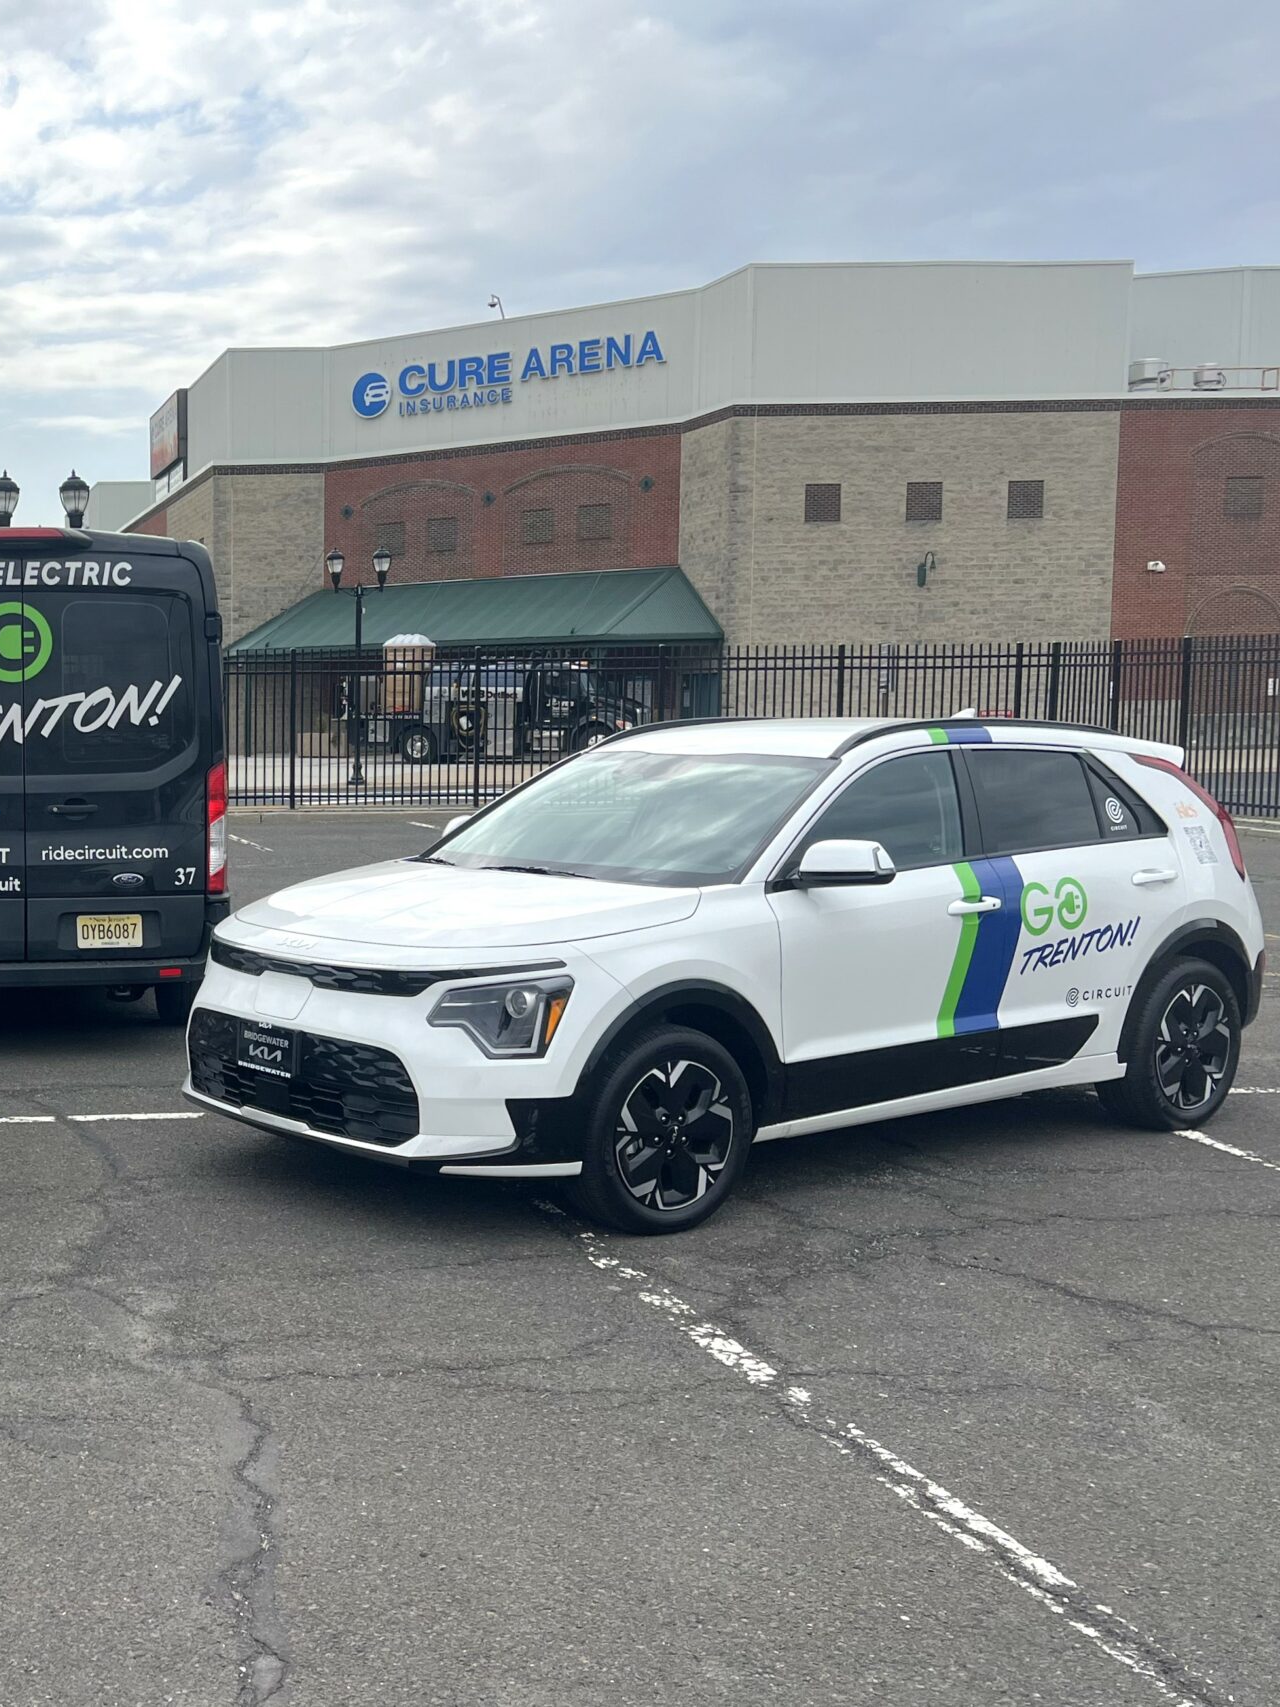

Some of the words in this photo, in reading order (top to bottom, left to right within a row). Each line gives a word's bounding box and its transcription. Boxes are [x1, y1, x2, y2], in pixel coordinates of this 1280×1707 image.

[398, 352, 512, 397] CURE
[520, 331, 666, 380] ARENA
[399, 388, 512, 417] INSURANCE
[41, 844, 169, 861] ridecircuit.com
[174, 867, 196, 885] 37
[1020, 877, 1087, 936] GO
[1020, 916, 1141, 975] TRENTON!
[1082, 985, 1133, 1001] CIRCUIT
[243, 1030, 289, 1049] BRIDGEWATER
[249, 1043, 282, 1063] KIA
[238, 1060, 291, 1079] BRIDGEWATER
